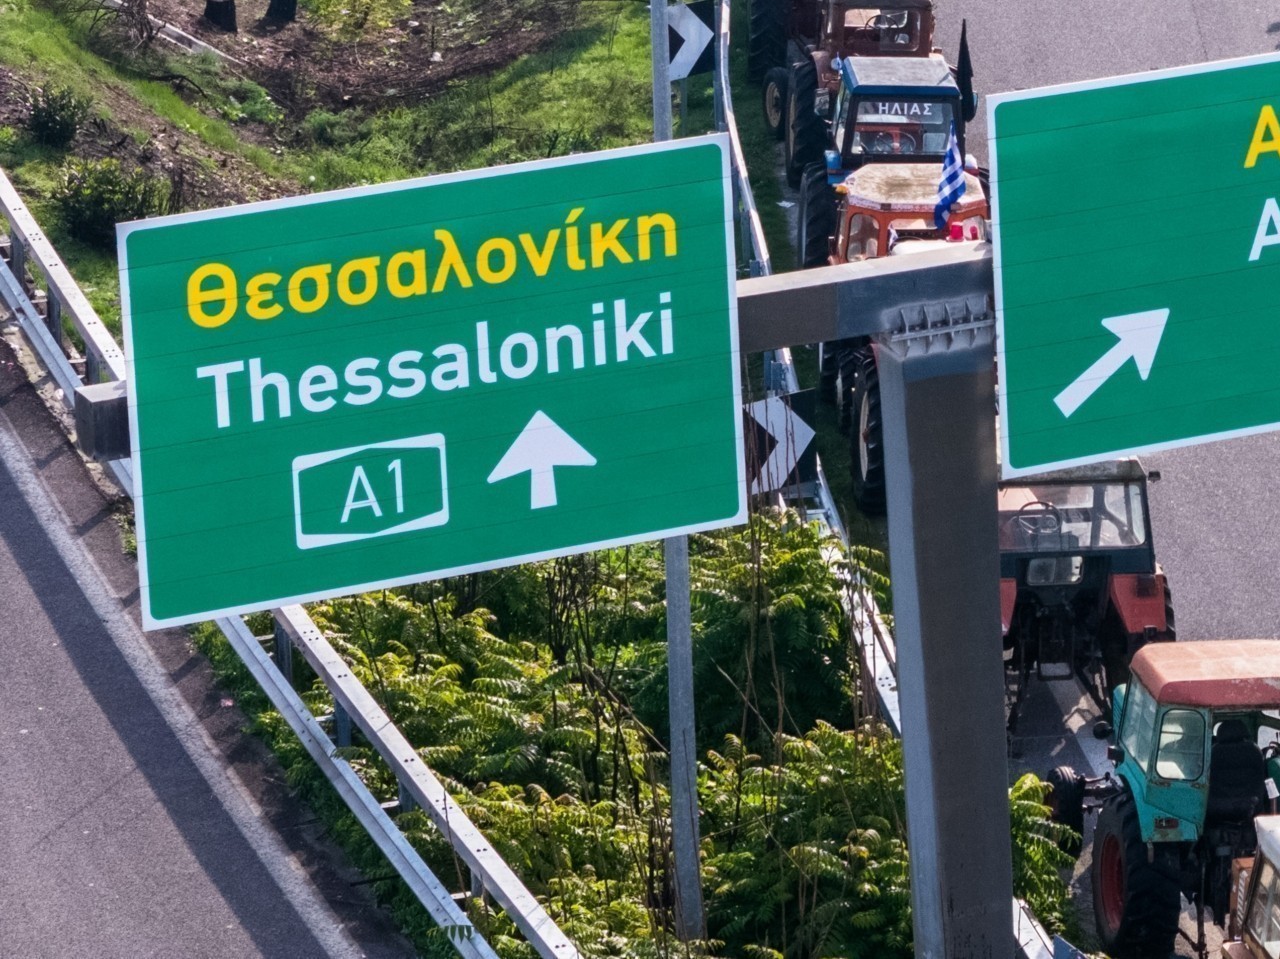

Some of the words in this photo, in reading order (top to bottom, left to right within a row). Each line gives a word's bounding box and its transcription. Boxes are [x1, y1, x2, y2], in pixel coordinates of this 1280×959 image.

[879, 102, 932, 115] ΗΛΙΑΣ
[187, 208, 677, 328] Θεσσαλονίκη
[196, 292, 674, 428] Thessaloniki
[340, 458, 404, 524] A1
